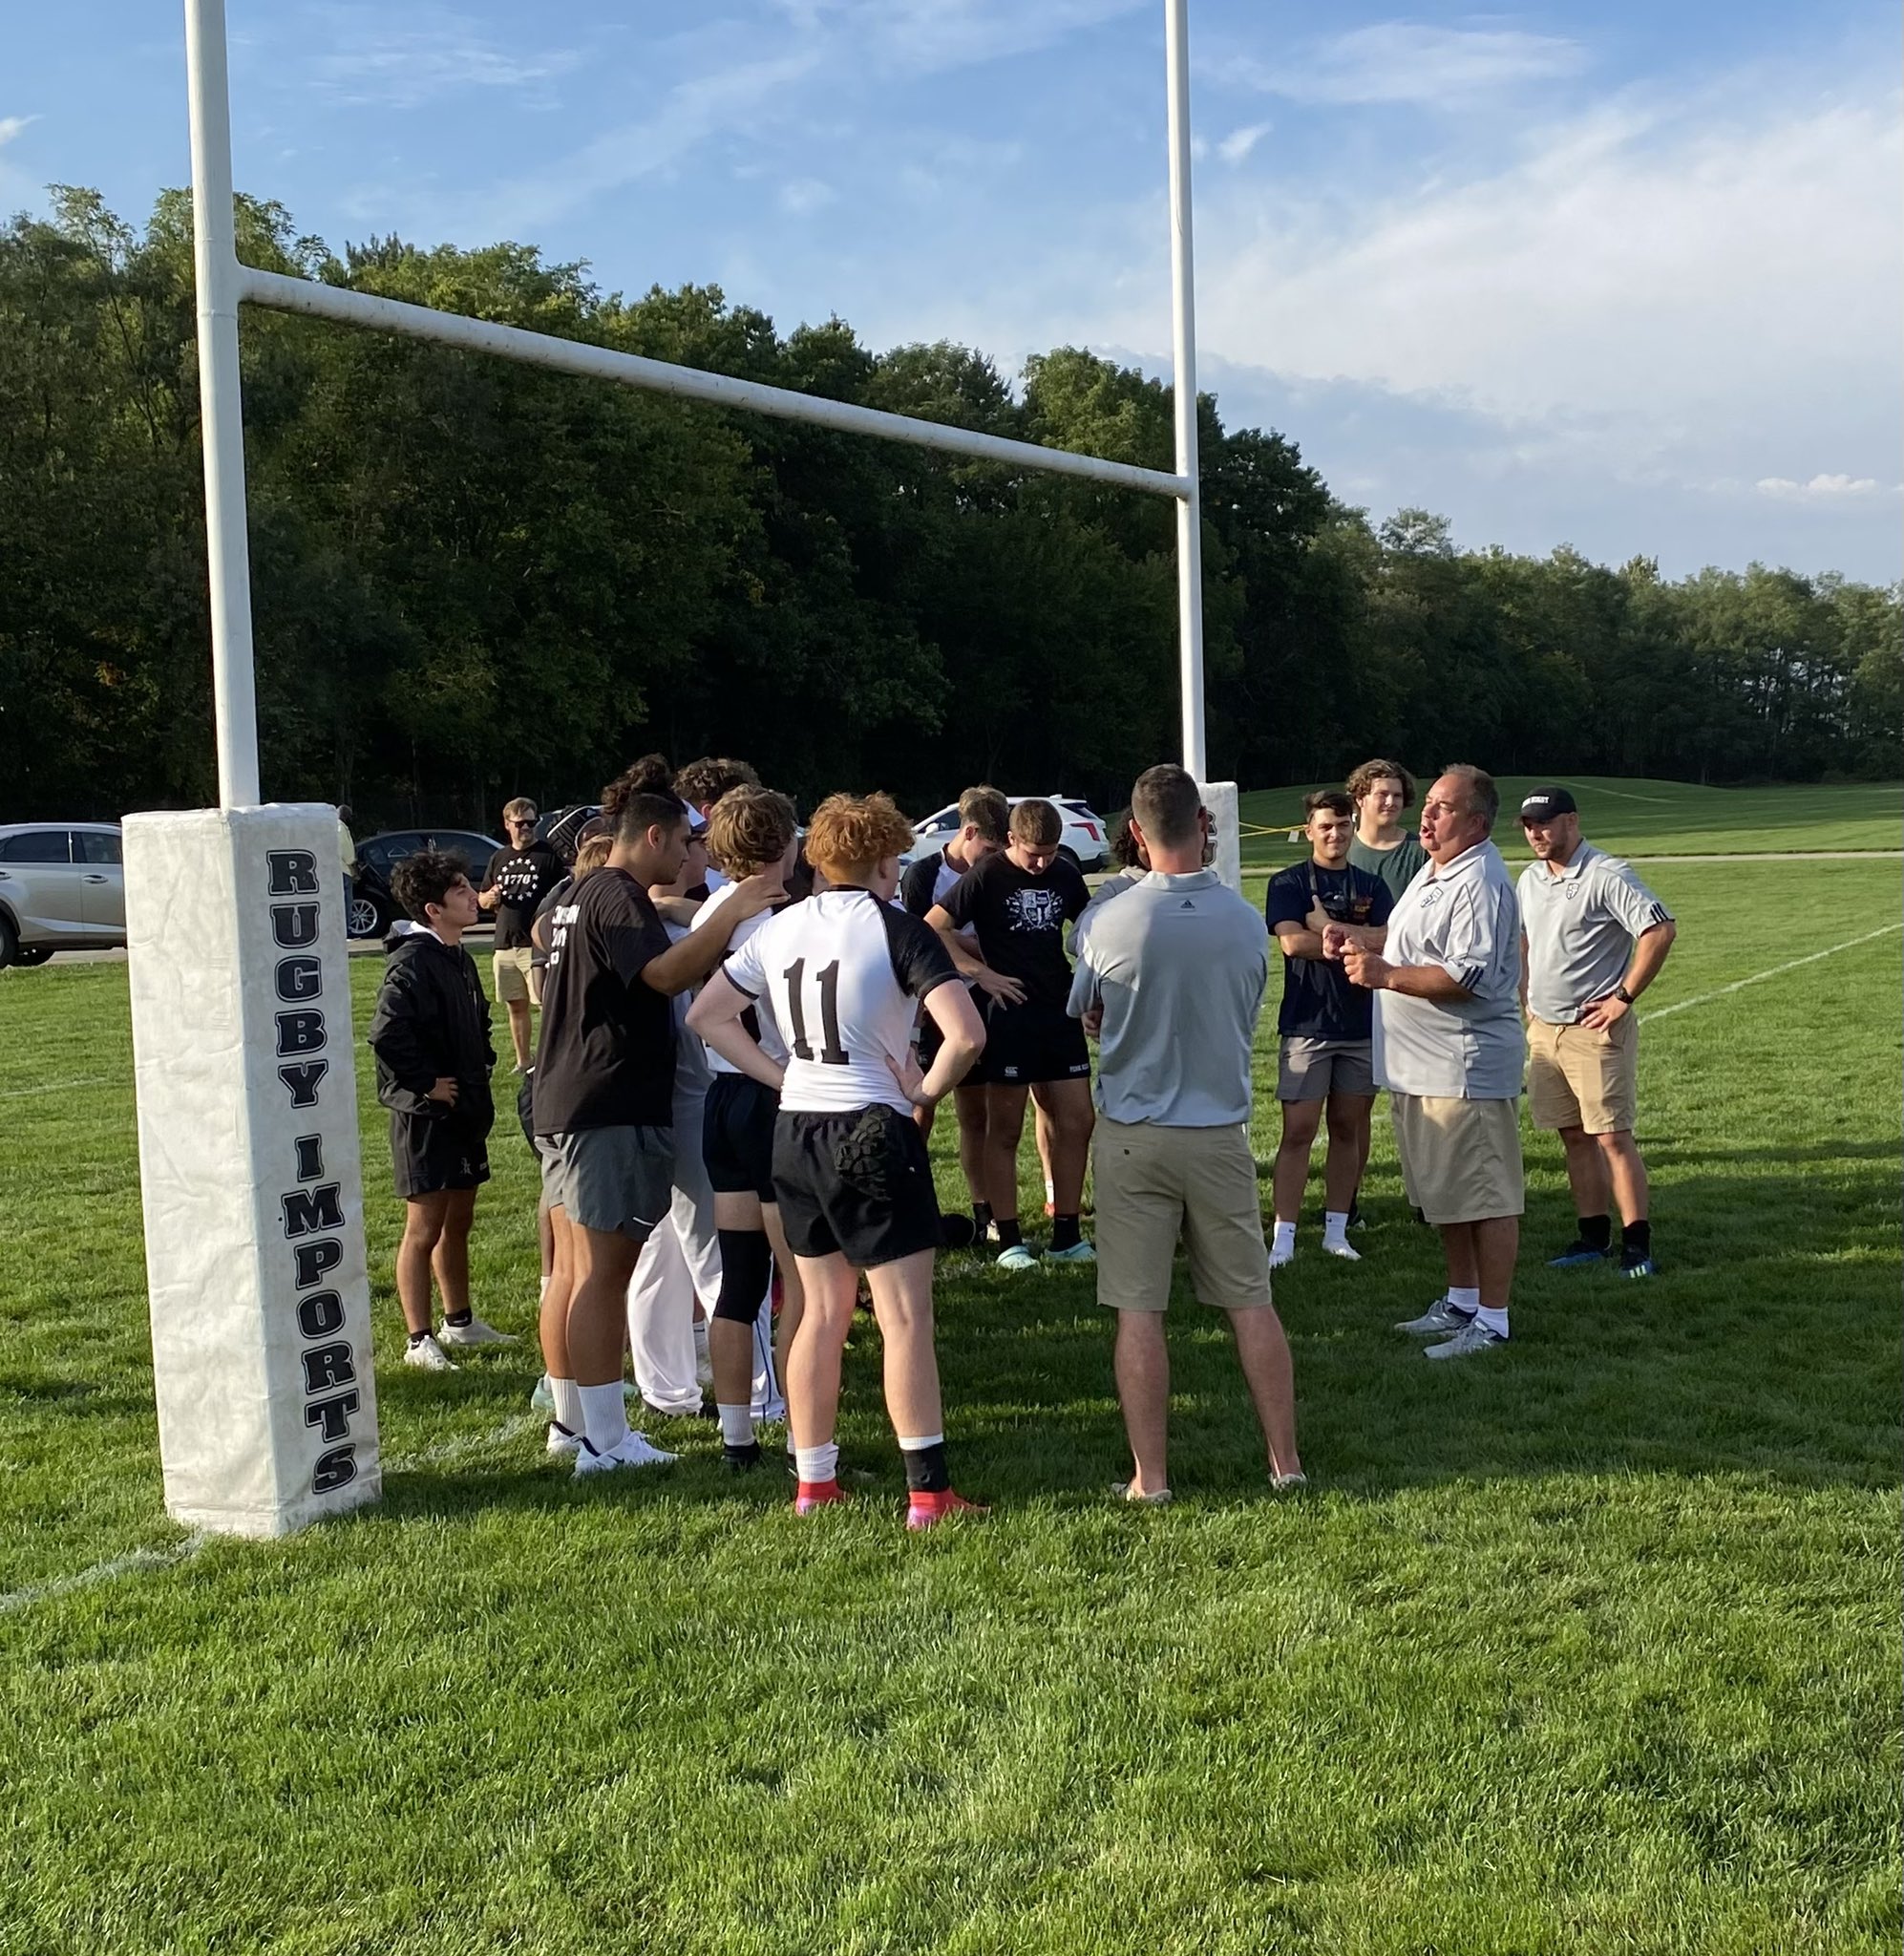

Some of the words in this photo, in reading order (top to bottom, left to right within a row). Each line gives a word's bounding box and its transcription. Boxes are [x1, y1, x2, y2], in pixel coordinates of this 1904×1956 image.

[266, 848, 329, 1109] RUGBY
[783, 957, 850, 1065] 11
[282, 1132, 359, 1496] IMPORTS
